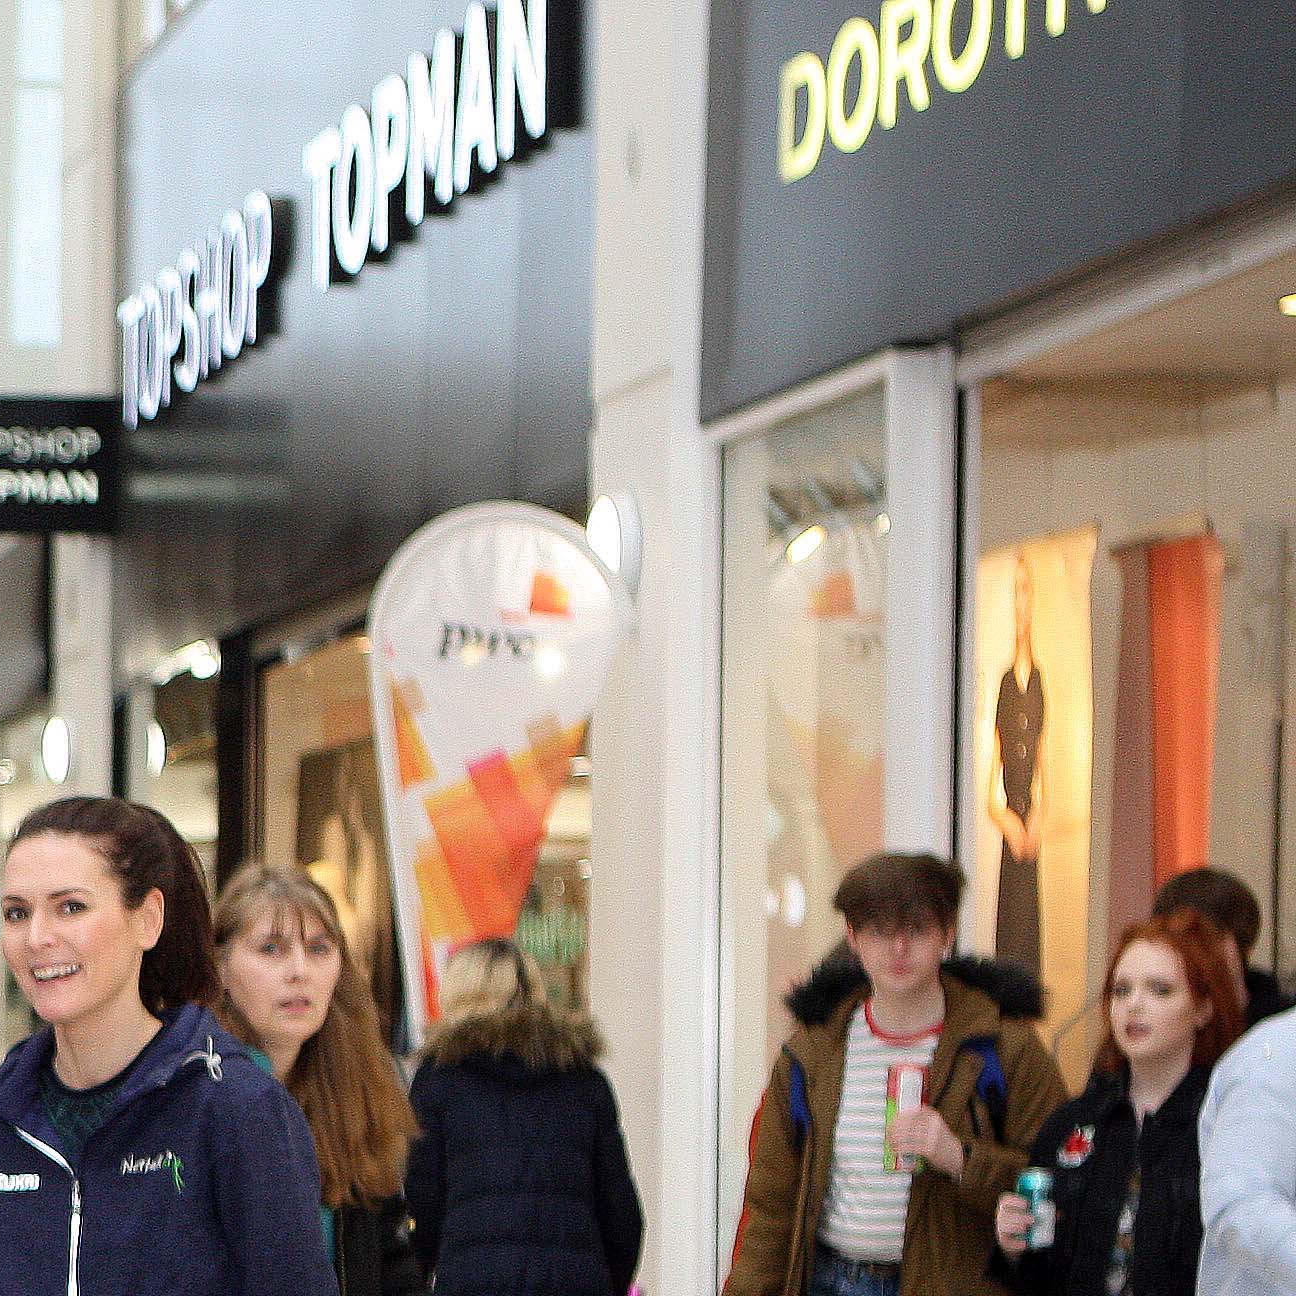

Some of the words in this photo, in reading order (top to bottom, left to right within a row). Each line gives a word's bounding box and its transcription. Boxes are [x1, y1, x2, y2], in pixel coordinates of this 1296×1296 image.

[117, 189, 273, 431] TOPSHOP
[303, 0, 549, 293] TOPMAN
[776, 0, 1107, 185] DORO
